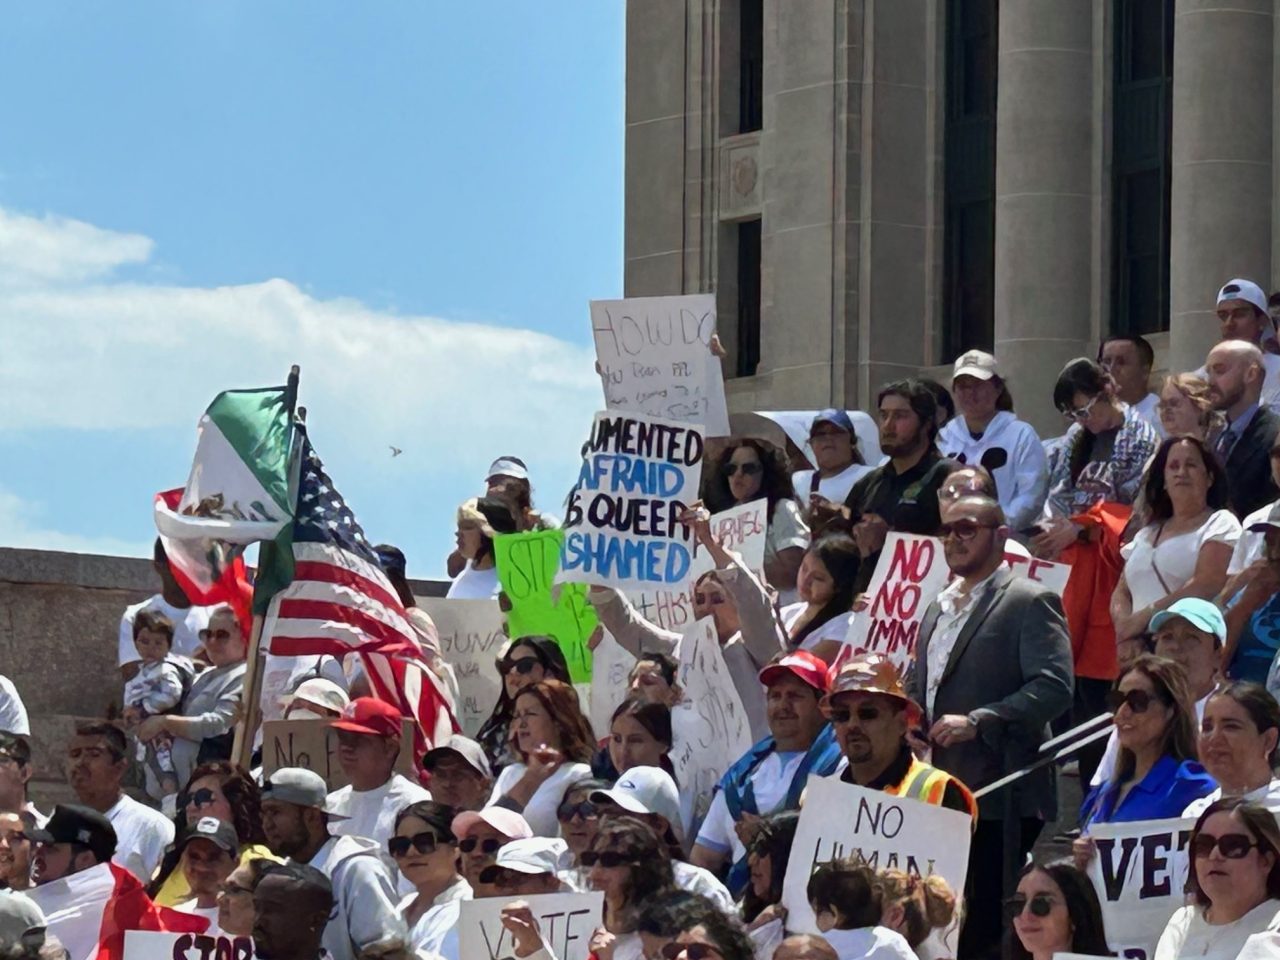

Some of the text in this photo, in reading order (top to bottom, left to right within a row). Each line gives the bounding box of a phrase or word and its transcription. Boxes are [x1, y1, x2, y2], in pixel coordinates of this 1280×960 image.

[577, 454, 685, 498] AFRAID
[588, 493, 690, 542] QUEER
[887, 539, 935, 583] NO
[871, 582, 921, 619] NO
[854, 796, 904, 839] NO
